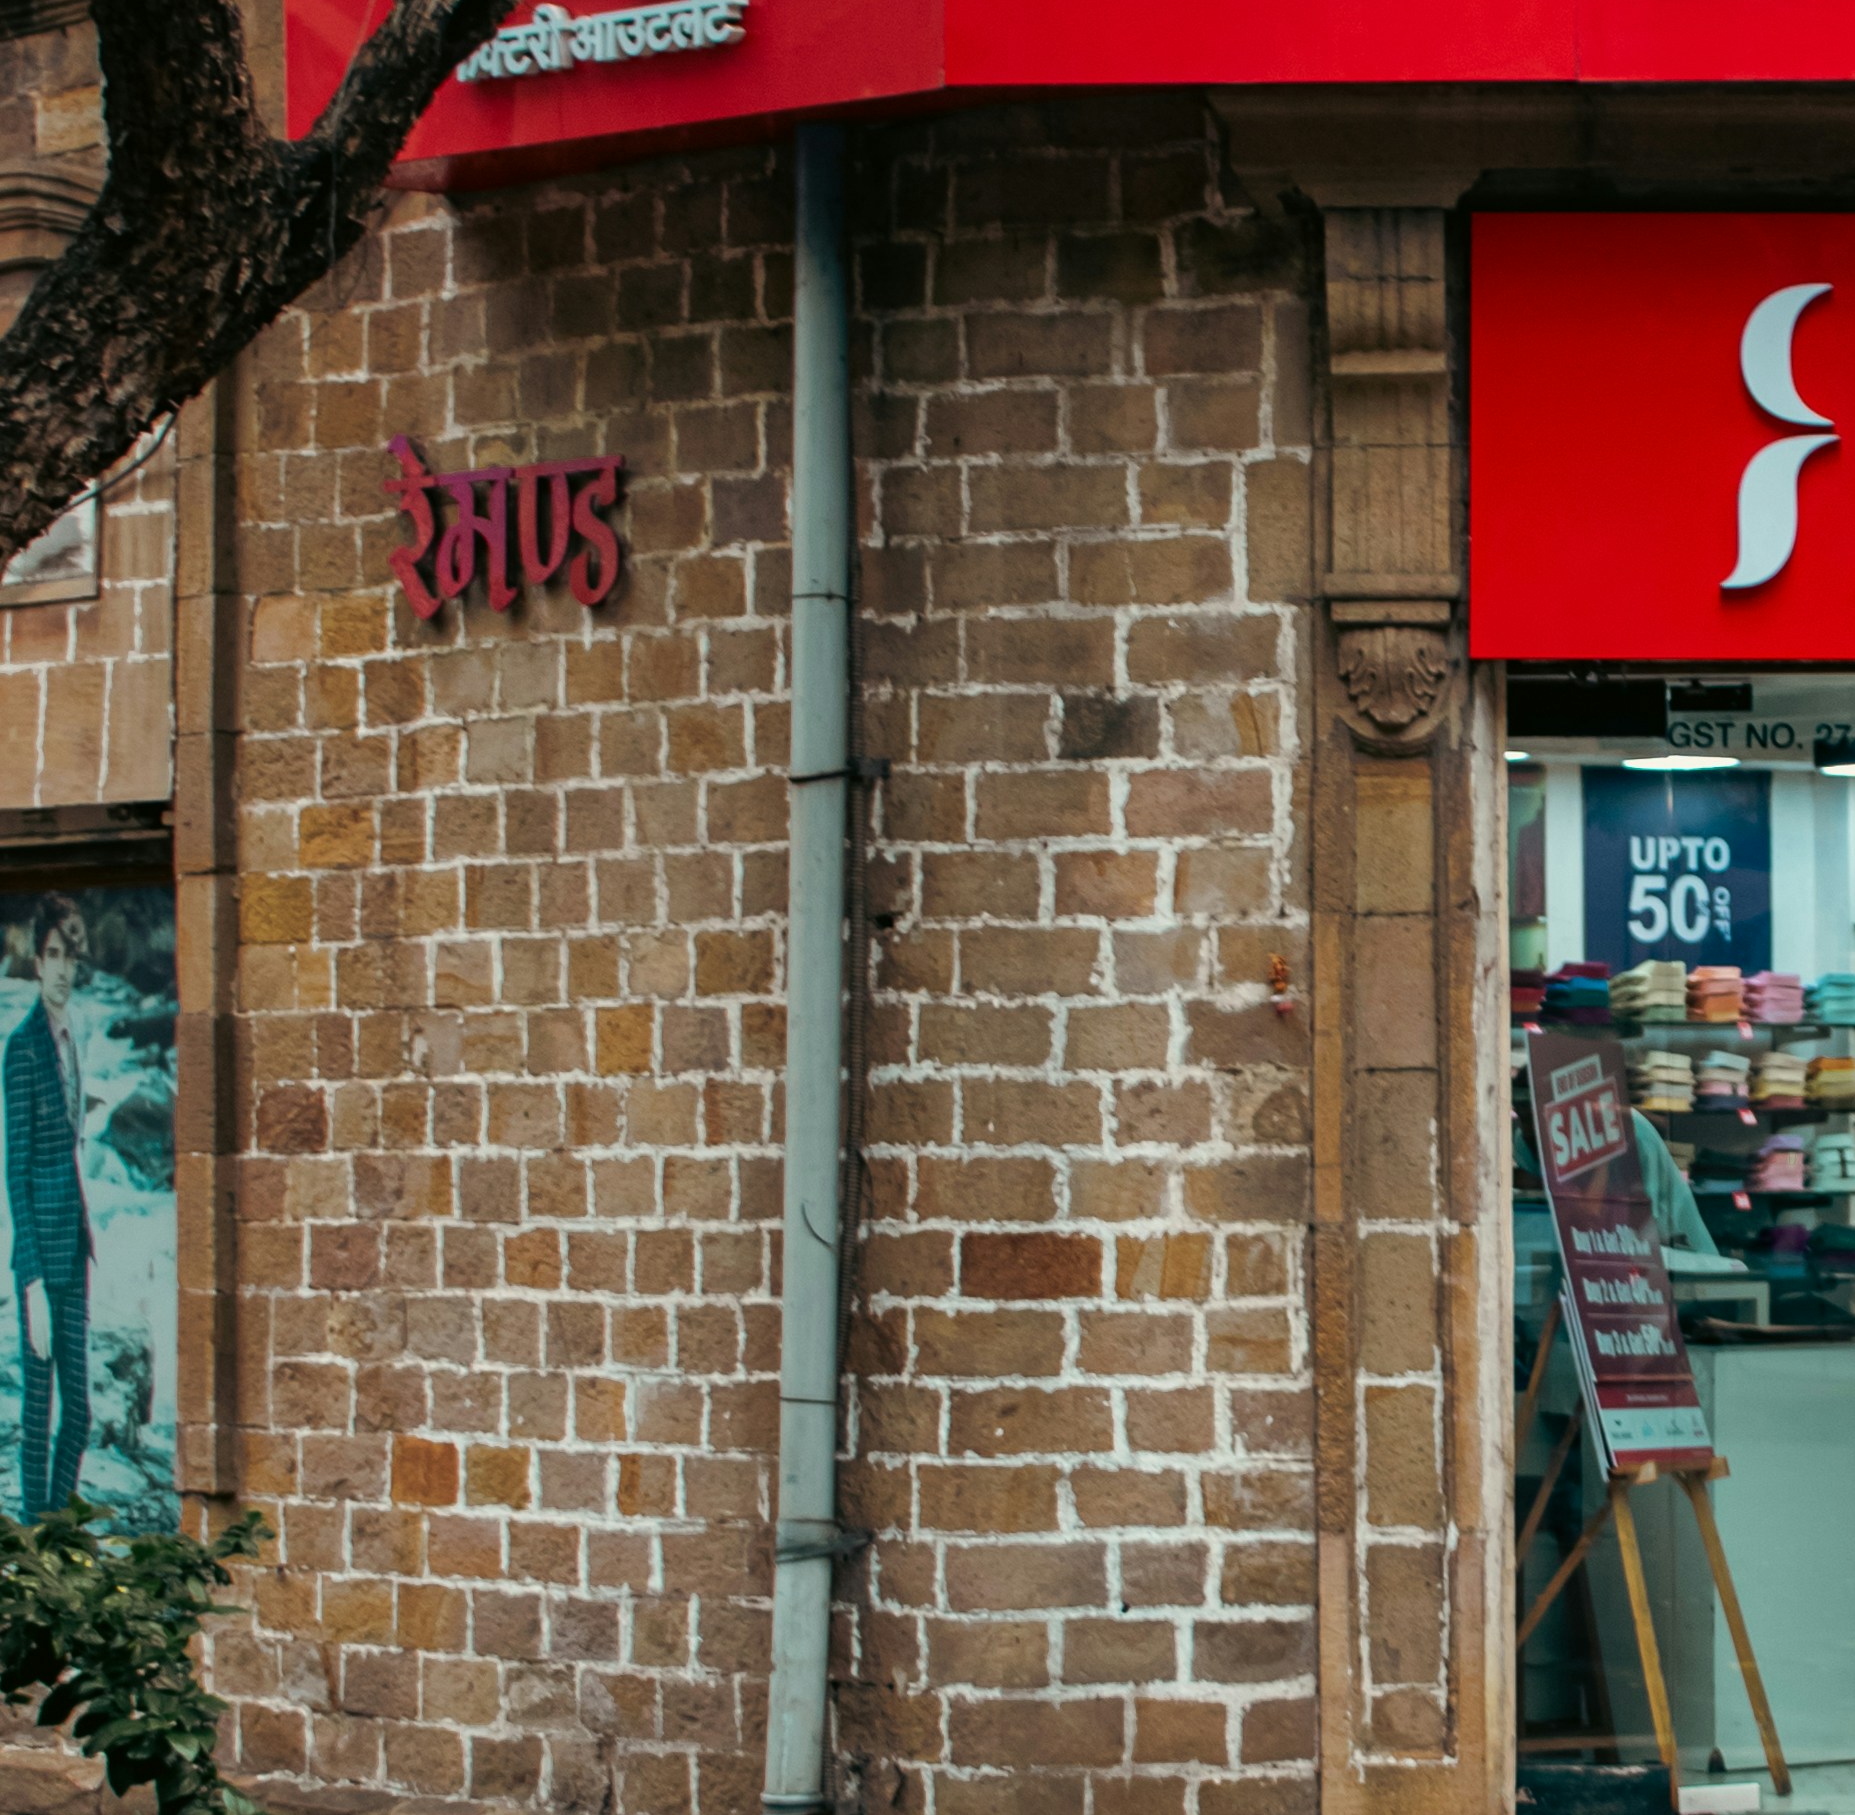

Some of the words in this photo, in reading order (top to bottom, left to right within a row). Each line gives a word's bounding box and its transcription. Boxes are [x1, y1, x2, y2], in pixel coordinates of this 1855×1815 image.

[1667, 721, 1736, 749] GST
[1745, 722, 1804, 750] NO.
[1629, 835, 1731, 873] UPTO
[1549, 1090, 1622, 1167] SALE
